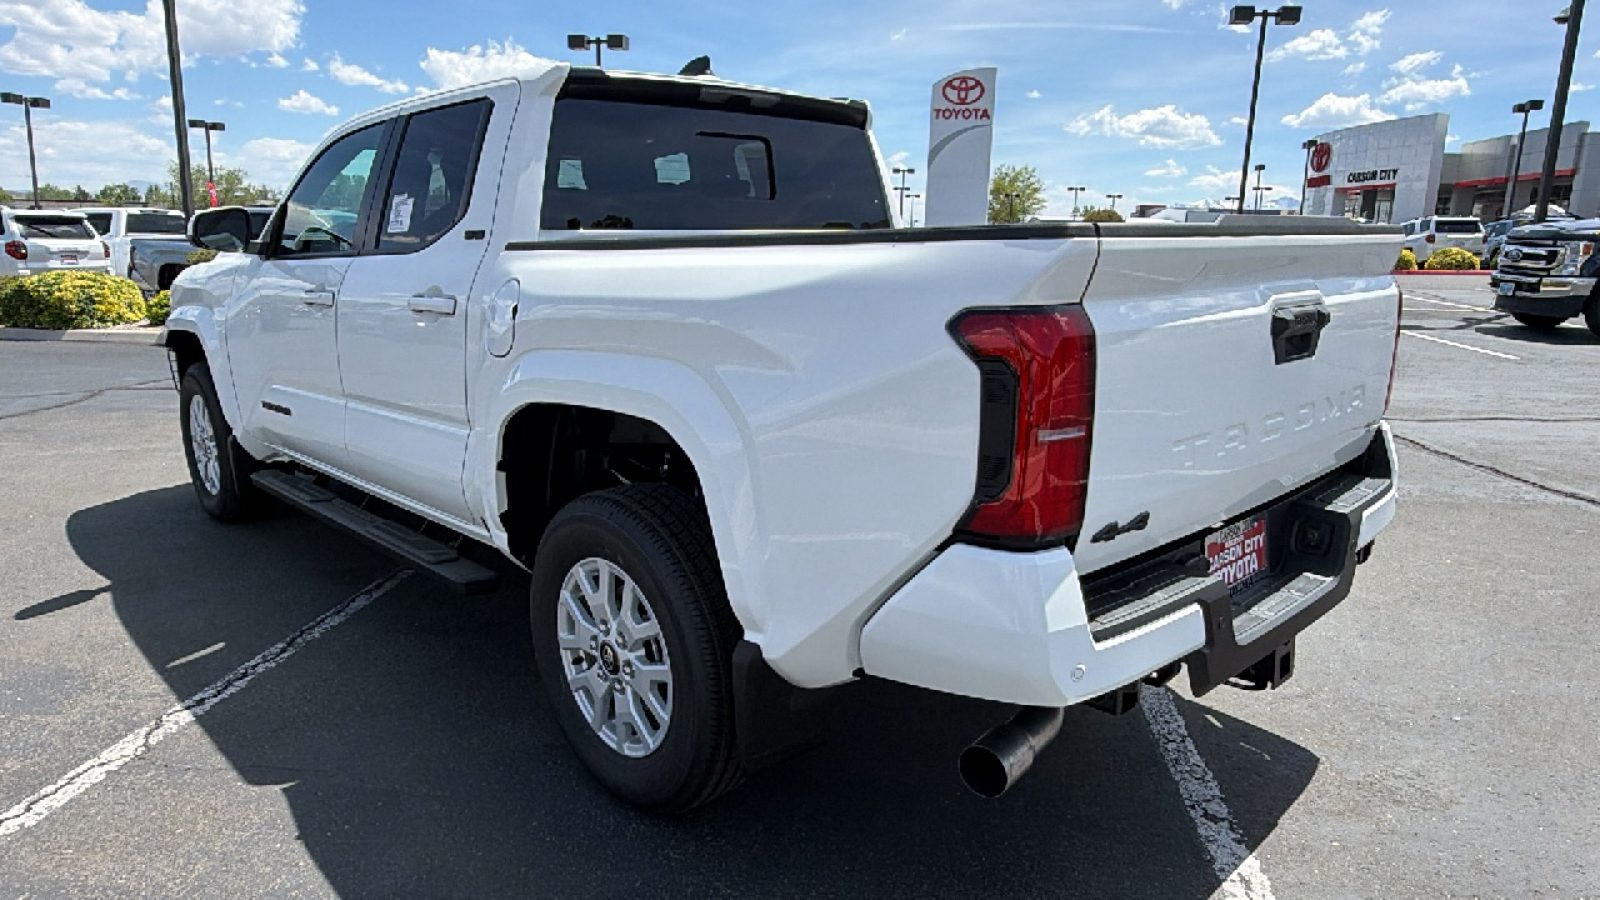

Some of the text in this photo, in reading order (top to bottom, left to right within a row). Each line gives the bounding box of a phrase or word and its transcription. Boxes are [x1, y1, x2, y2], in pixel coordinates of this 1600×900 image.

[933, 108, 991, 121] TOYOTA
[1347, 168, 1399, 182] CARSON CITY
[1244, 533, 1266, 553] CITY
